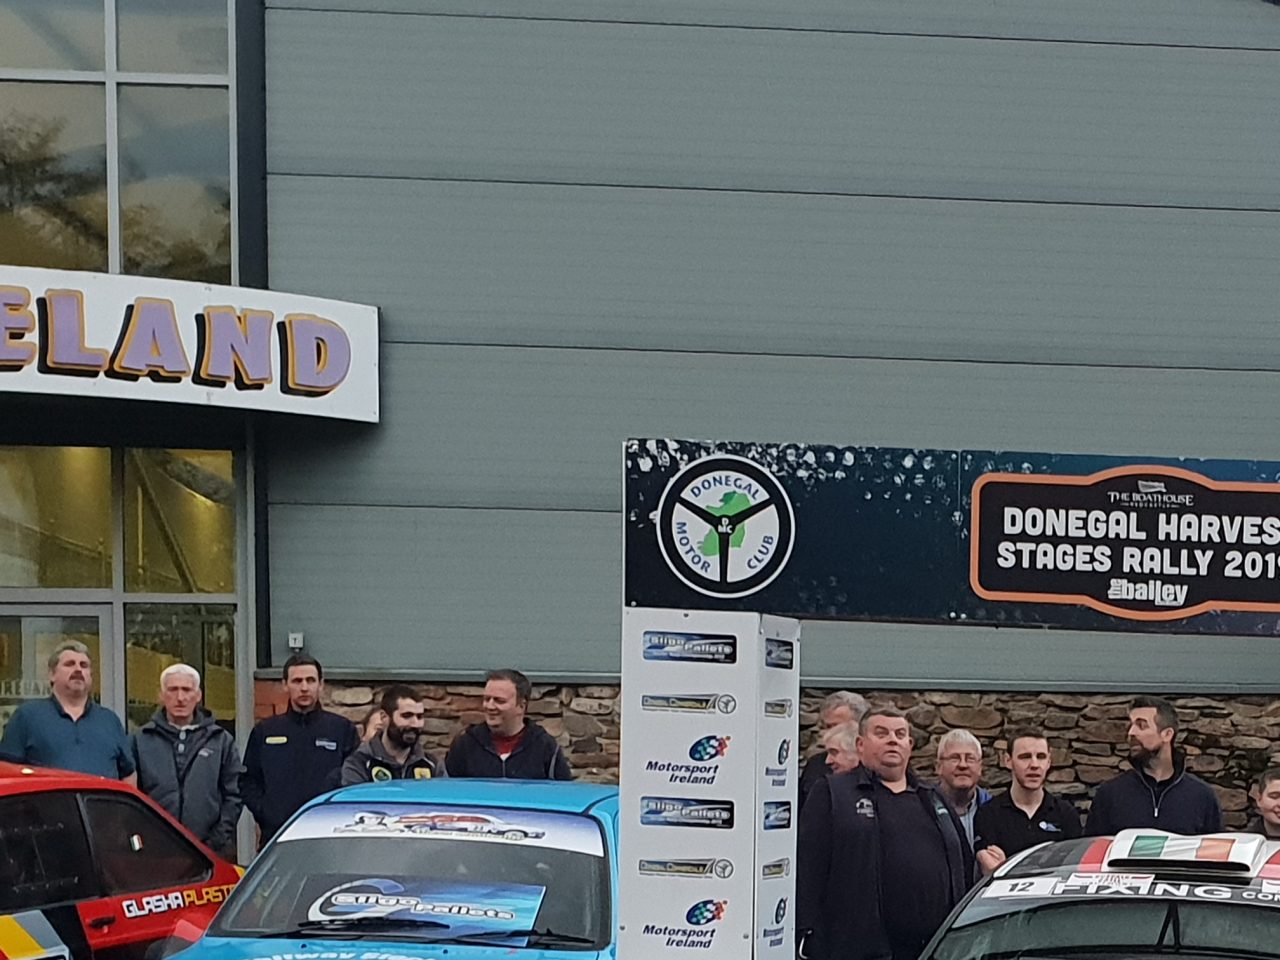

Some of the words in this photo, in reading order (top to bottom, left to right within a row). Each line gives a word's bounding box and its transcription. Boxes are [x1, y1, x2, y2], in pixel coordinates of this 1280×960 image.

[690, 475, 760, 500] DONEGAL
[1107, 491, 1130, 503] THE
[1132, 492, 1194, 506] BOATHOUSE
[1003, 507, 1147, 540] DONEGAL
[676, 522, 711, 573] MOTOR
[746, 534, 774, 569] CLUB
[997, 542, 1111, 572] STAGES
[1122, 547, 1214, 577] RALLY
[646, 761, 719, 776] Motorsport
[669, 770, 715, 785] Ireland
[1008, 881, 1034, 893] 12
[1053, 884, 1232, 899] FIXING
[643, 925, 716, 940] Motorsport
[666, 935, 713, 949] Ireland
